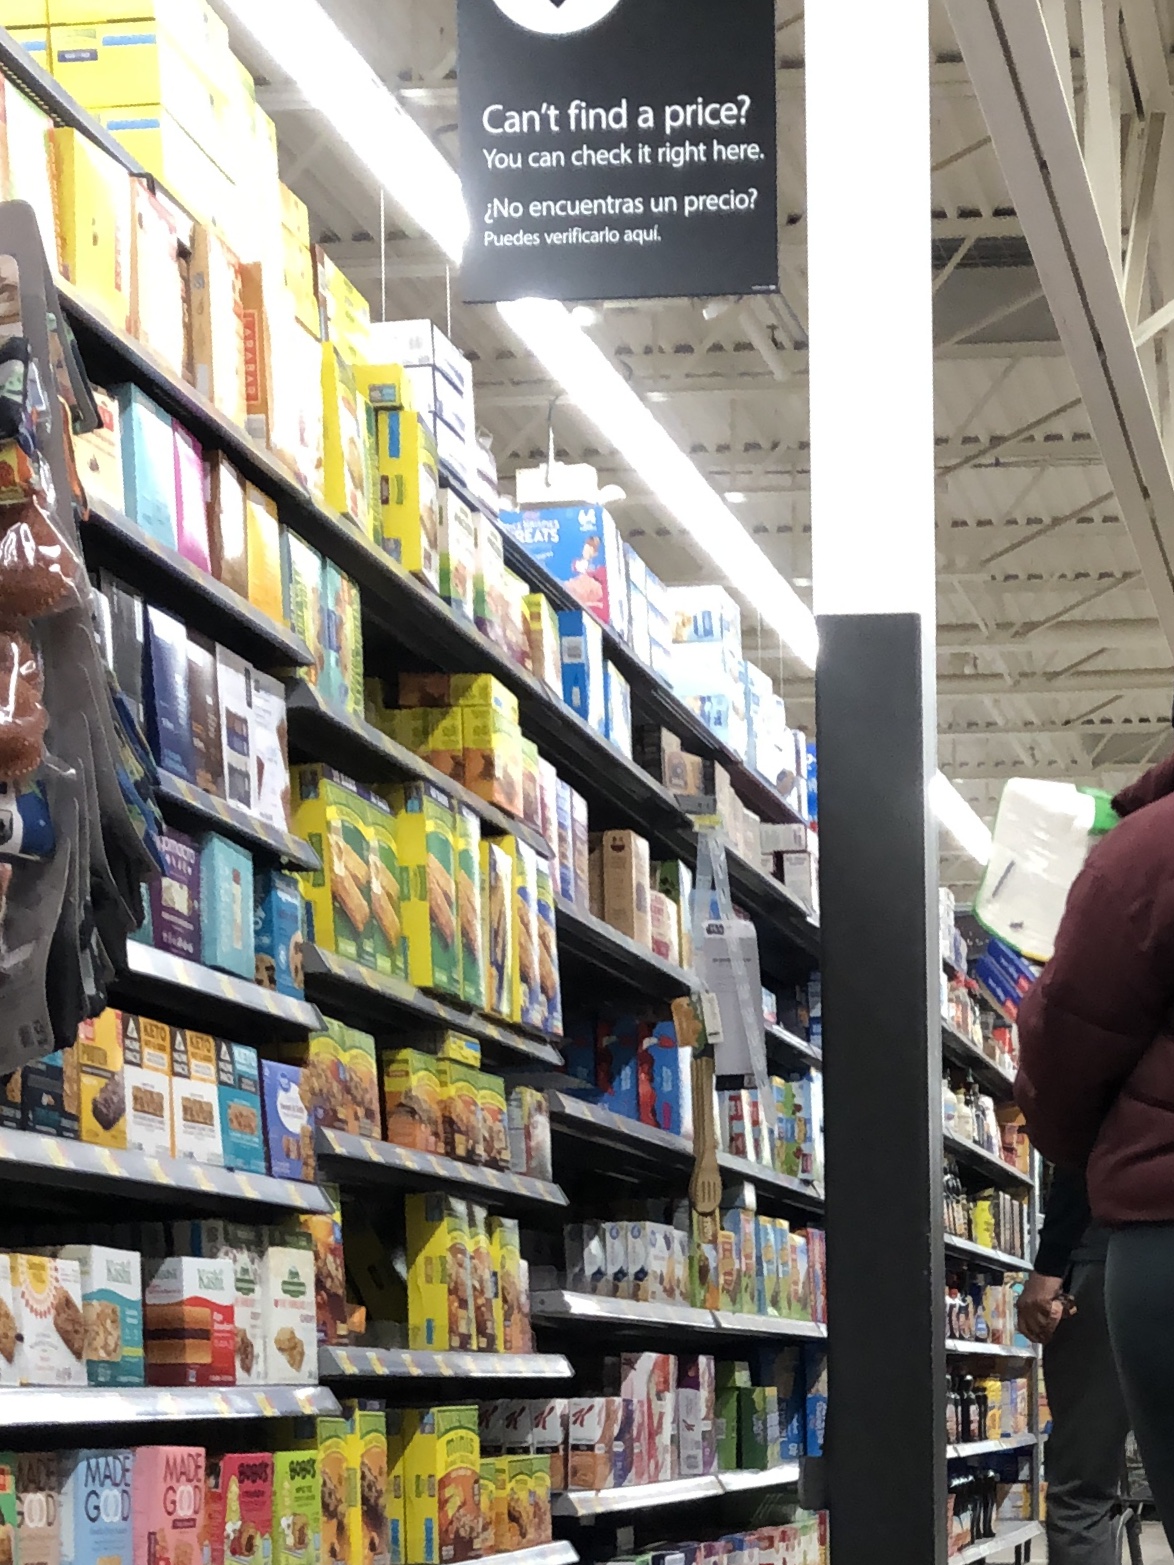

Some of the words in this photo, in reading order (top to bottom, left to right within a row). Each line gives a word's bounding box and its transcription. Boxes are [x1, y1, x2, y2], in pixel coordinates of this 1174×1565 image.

[482, 102, 560, 134] Can't
[567, 98, 628, 132] find
[637, 106, 655, 129] a
[665, 95, 751, 134] price?
[482, 147, 522, 169] You
[528, 150, 565, 168] can
[571, 143, 631, 167] check
[637, 142, 652, 164] it
[657, 140, 707, 168] right
[712, 139, 765, 161] here.
[484, 197, 524, 224] ¿No
[529, 195, 644, 217] encuentras
[650, 194, 677, 213] un
[684, 188, 758, 217] precio?
[484, 229, 541, 247] Puedes
[544, 226, 620, 245] verificarlo
[623, 224, 662, 245] aquí.
[84, 1455, 131, 1488] MADE
[163, 1452, 203, 1484] MADE
